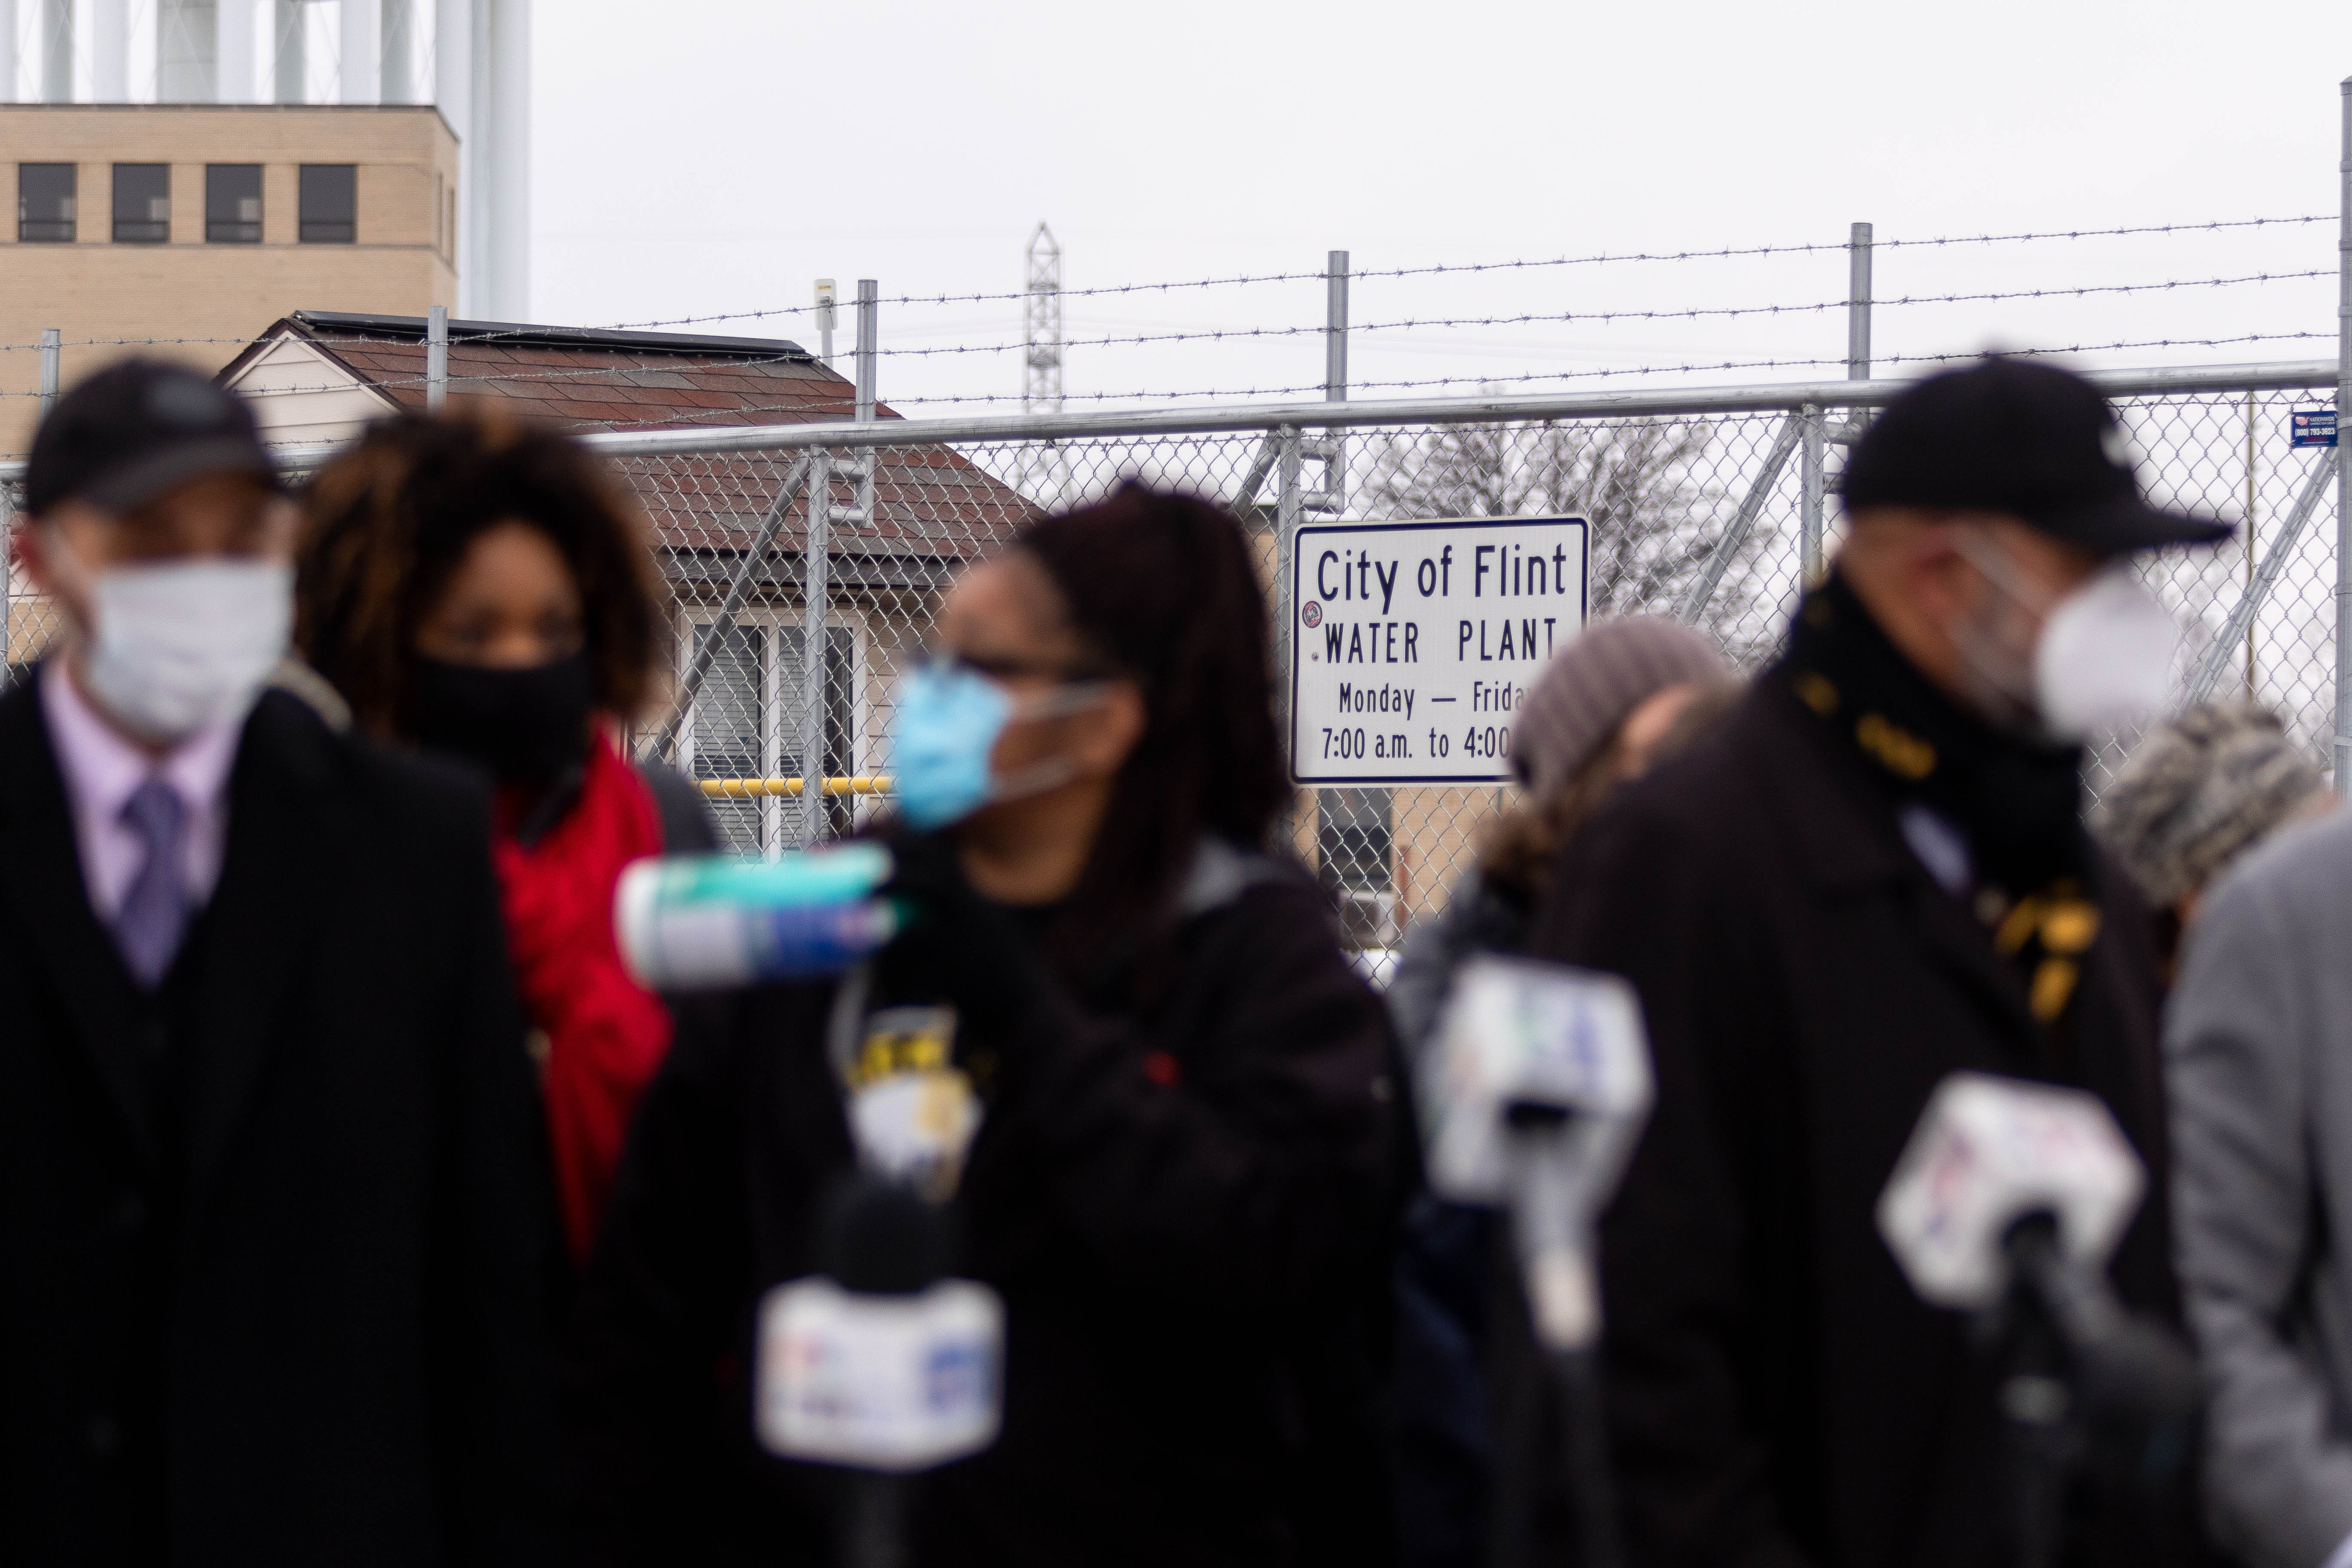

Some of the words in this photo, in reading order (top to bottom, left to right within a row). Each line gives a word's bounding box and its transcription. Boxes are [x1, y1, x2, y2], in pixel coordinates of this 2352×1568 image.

[2295, 428, 2308, 437] (800)
[2310, 427, 2335, 435] 793-3623
[1317, 549, 1399, 615] City
[1418, 545, 1452, 597] of
[1475, 543, 1567, 597] Flint
[1325, 622, 1418, 664] WATER
[1459, 618, 1556, 662] PLANT
[1339, 682, 1415, 721] Monday
[1474, 681, 1525, 712] Frida
[1323, 728, 1365, 759] 7:00
[1375, 734, 1413, 758] a.m.
[1429, 726, 1449, 758] to
[1464, 726, 1510, 758] 4:00
